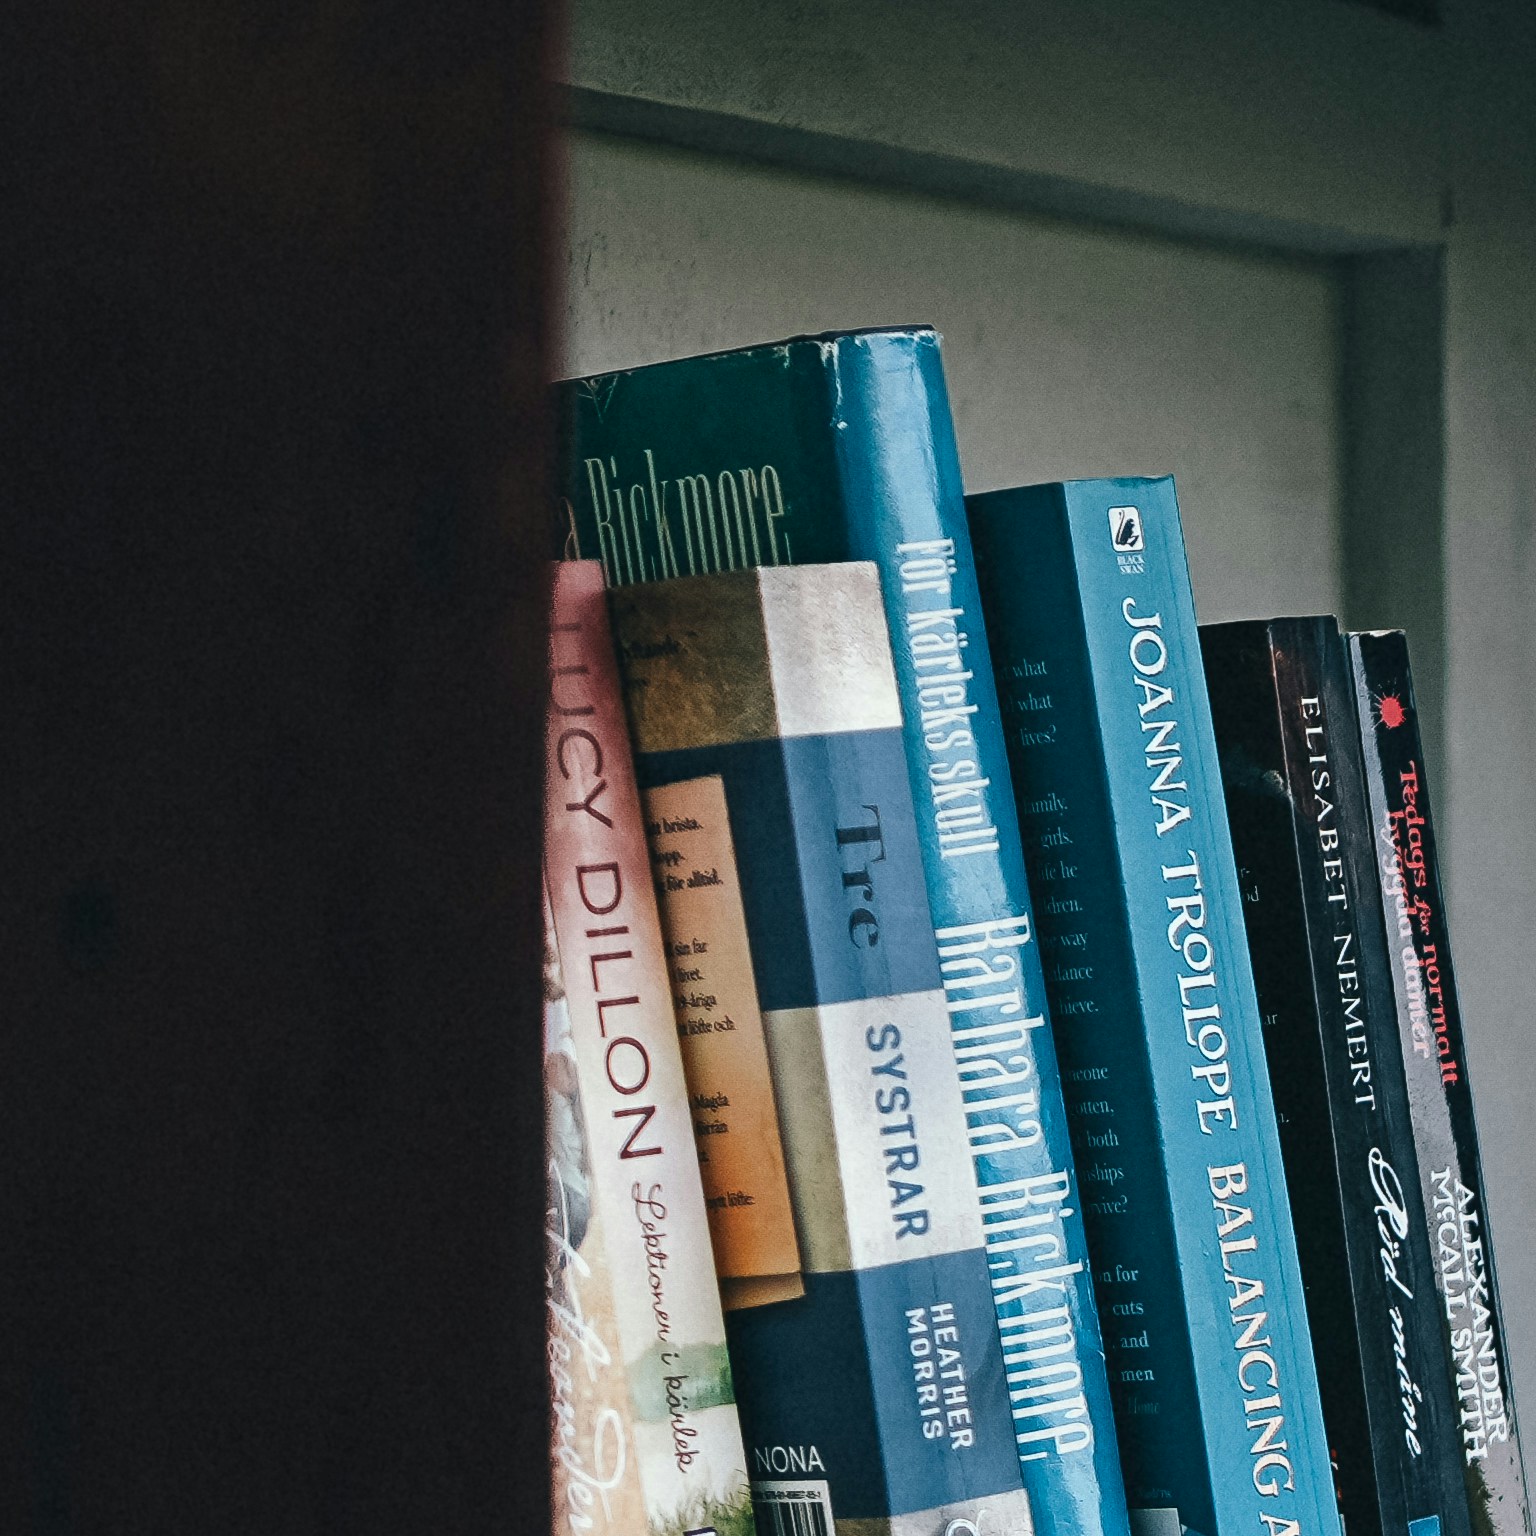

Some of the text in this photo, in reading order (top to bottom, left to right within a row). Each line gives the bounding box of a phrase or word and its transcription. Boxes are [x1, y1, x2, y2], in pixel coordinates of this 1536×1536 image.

[895, 536, 1000, 860] För kärleks skull
[834, 804, 931, 1241] Tre SYSTRAR
[934, 911, 1045, 1157] Barbara
[1122, 596, 1190, 838] JOANNA
[1161, 850, 1237, 1135] TROLLOPE
[1207, 1162, 1295, 1499] BALANCING
[1381, 811, 1430, 1060] byggda damer
[1400, 760, 1427, 887] Tedags
[1423, 943, 1459, 1086] normalt
[576, 861, 664, 1160] DILLON
[631, 1180, 673, 1350] Lektioner
[662, 1376, 693, 1475] kärlek
[1300, 696, 1422, 1459] ELISABET NEMERT Röd måne
[903, 1307, 945, 1442] MORRIS
[929, 1301, 975, 1451] HEATHER
[1450, 1328, 1489, 1468] SMITH
[1455, 1178, 1508, 1444] ALEXANDER
[754, 1445, 828, 1473] NONA
